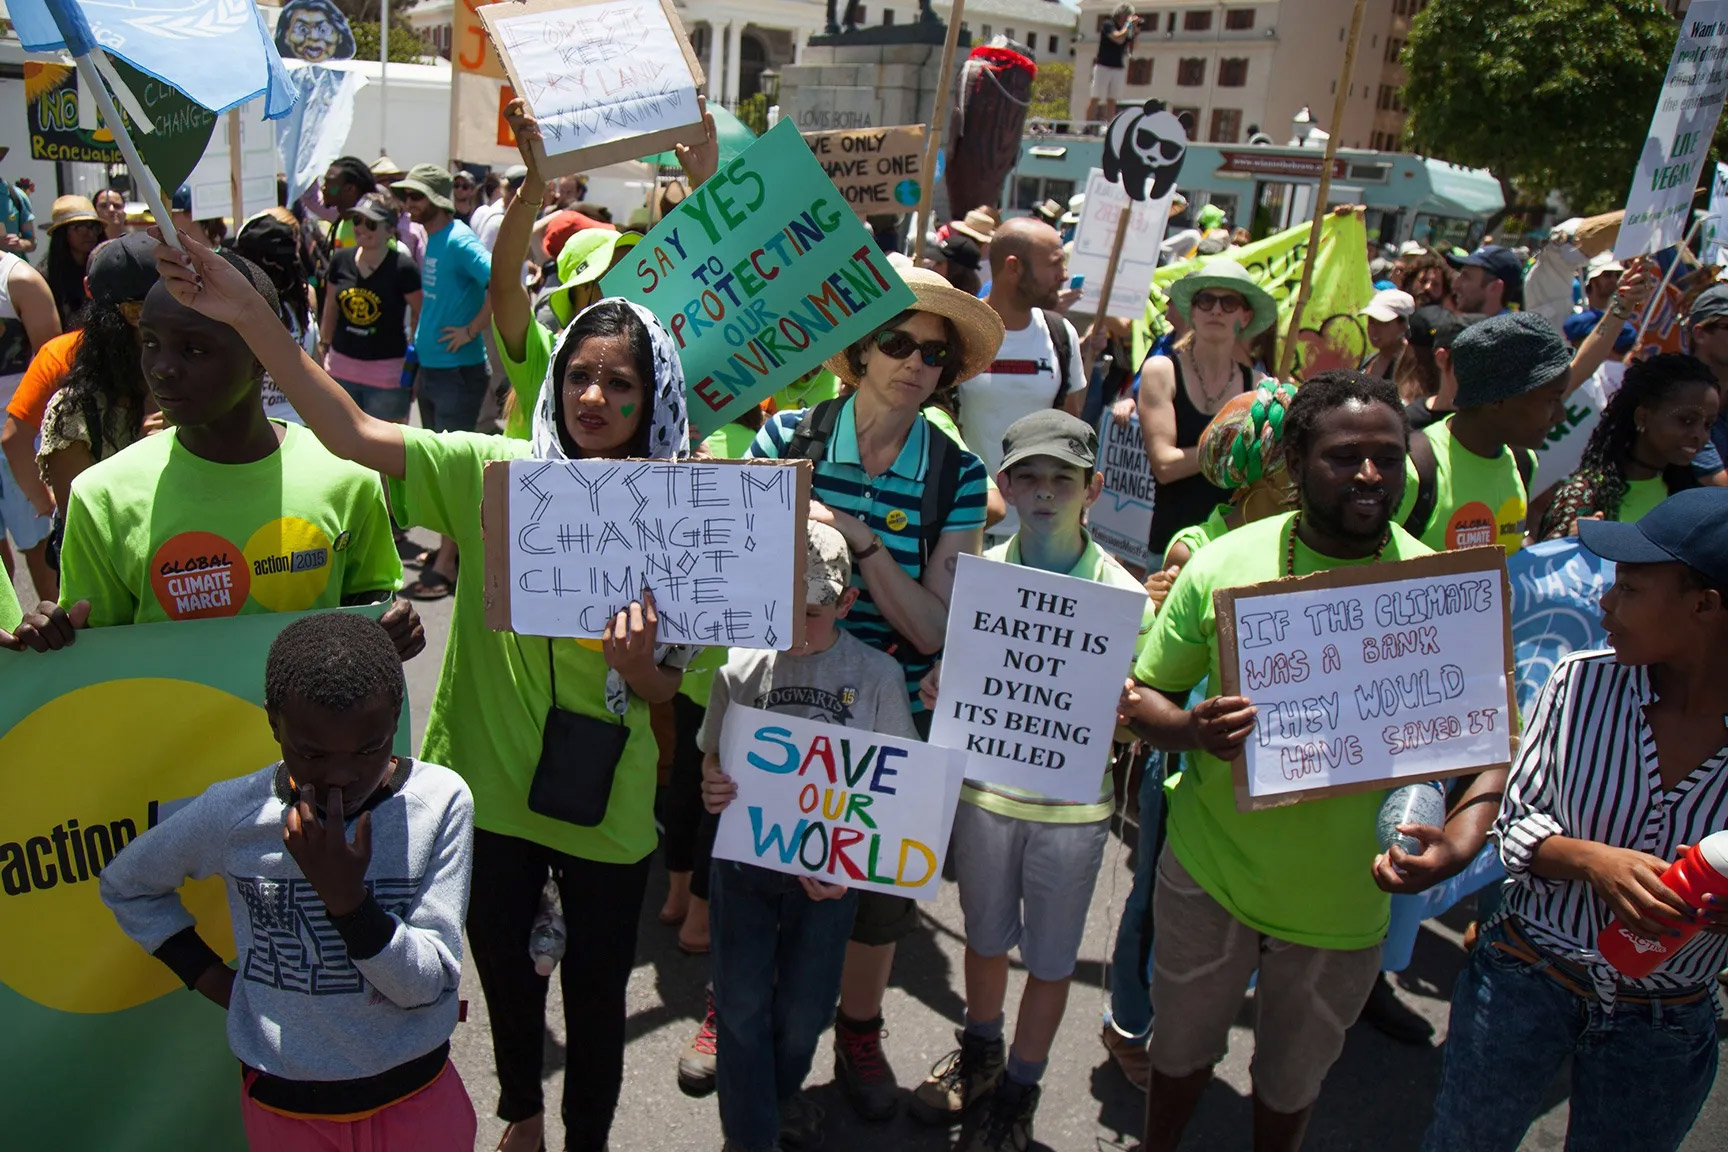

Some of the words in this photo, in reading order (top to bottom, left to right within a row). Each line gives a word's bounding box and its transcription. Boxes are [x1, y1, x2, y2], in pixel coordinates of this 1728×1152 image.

[1690, 21, 1716, 38] Want
[558, 41, 638, 69] KEEP
[524, 67, 591, 106] DRY
[596, 59, 666, 96] LAND
[39, 88, 79, 132] NO
[155, 103, 213, 139] CHANGE
[833, 111, 872, 127] BOTHA
[805, 136, 831, 154] WE
[841, 133, 887, 153] ONLY
[1670, 130, 1701, 159] LIVE
[820, 158, 868, 179] HAVE
[876, 153, 919, 176] ONE
[637, 227, 688, 294] SAY
[680, 157, 766, 246] YES
[670, 198, 842, 350] PROTECTING
[691, 255, 724, 287] TO
[692, 245, 892, 412] ENVIRONMENT
[723, 298, 780, 347] OUR
[1109, 422, 1146, 450] CHAN
[518, 460, 792, 523] SYSTEM
[1104, 467, 1156, 501] CHANGE
[518, 512, 757, 556] CHANGE!
[1456, 530, 1491, 546] CLIMATE
[160, 552, 234, 576] GLOBAL
[644, 549, 740, 577] NOT
[167, 570, 233, 597] CLIMATE
[175, 589, 232, 615] MARCH
[518, 565, 729, 604] CLIMATE
[1017, 587, 1078, 618] THE
[579, 600, 778, 648] CNGE!
[972, 610, 1075, 648] EARTH
[1080, 632, 1109, 655] IS
[1241, 609, 1290, 649] IF
[1304, 598, 1364, 636] THE
[1375, 578, 1493, 628] CLIMATE
[1002, 648, 1066, 677] NOT
[1245, 649, 1310, 690] WAS
[1322, 643, 1341, 674] A
[1362, 625, 1441, 664] BANK
[982, 676, 1073, 711] DYING
[1254, 690, 1340, 748] THEY
[1353, 663, 1465, 721] WOULD
[952, 701, 998, 727] ITS
[1004, 711, 1092, 746] BEING
[746, 725, 909, 796] SAVE
[966, 733, 1066, 770] KILLED
[1280, 734, 1364, 781] HAVE
[1381, 715, 1462, 756] SAVED
[1467, 707, 1499, 735] IT
[798, 782, 878, 830] OUR
[747, 805, 938, 888] WORLD
